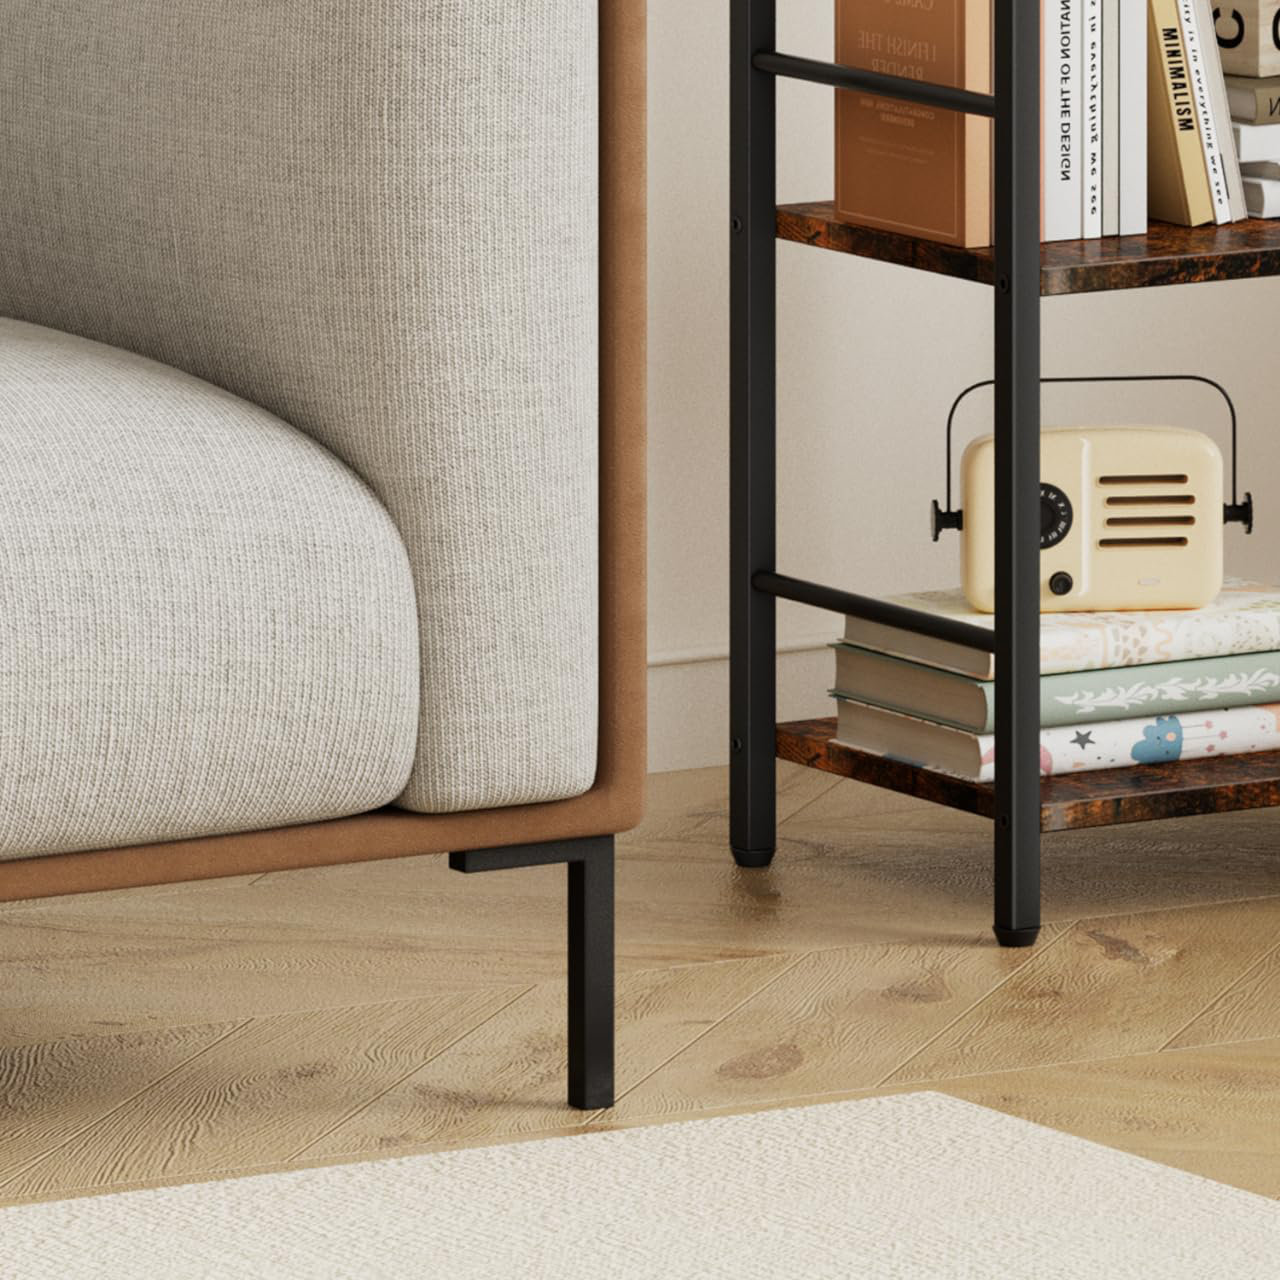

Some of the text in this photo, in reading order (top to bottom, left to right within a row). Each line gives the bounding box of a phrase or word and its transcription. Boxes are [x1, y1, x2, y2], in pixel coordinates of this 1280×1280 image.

[1188, 31, 1195, 42] is
[1212, 7, 1244, 48] C
[1191, 49, 1198, 62] in
[1162, 27, 1195, 132] MINIMALISM
[1195, 69, 1214, 149] everything
[1210, 155, 1218, 175] we
[1215, 181, 1223, 205] see
